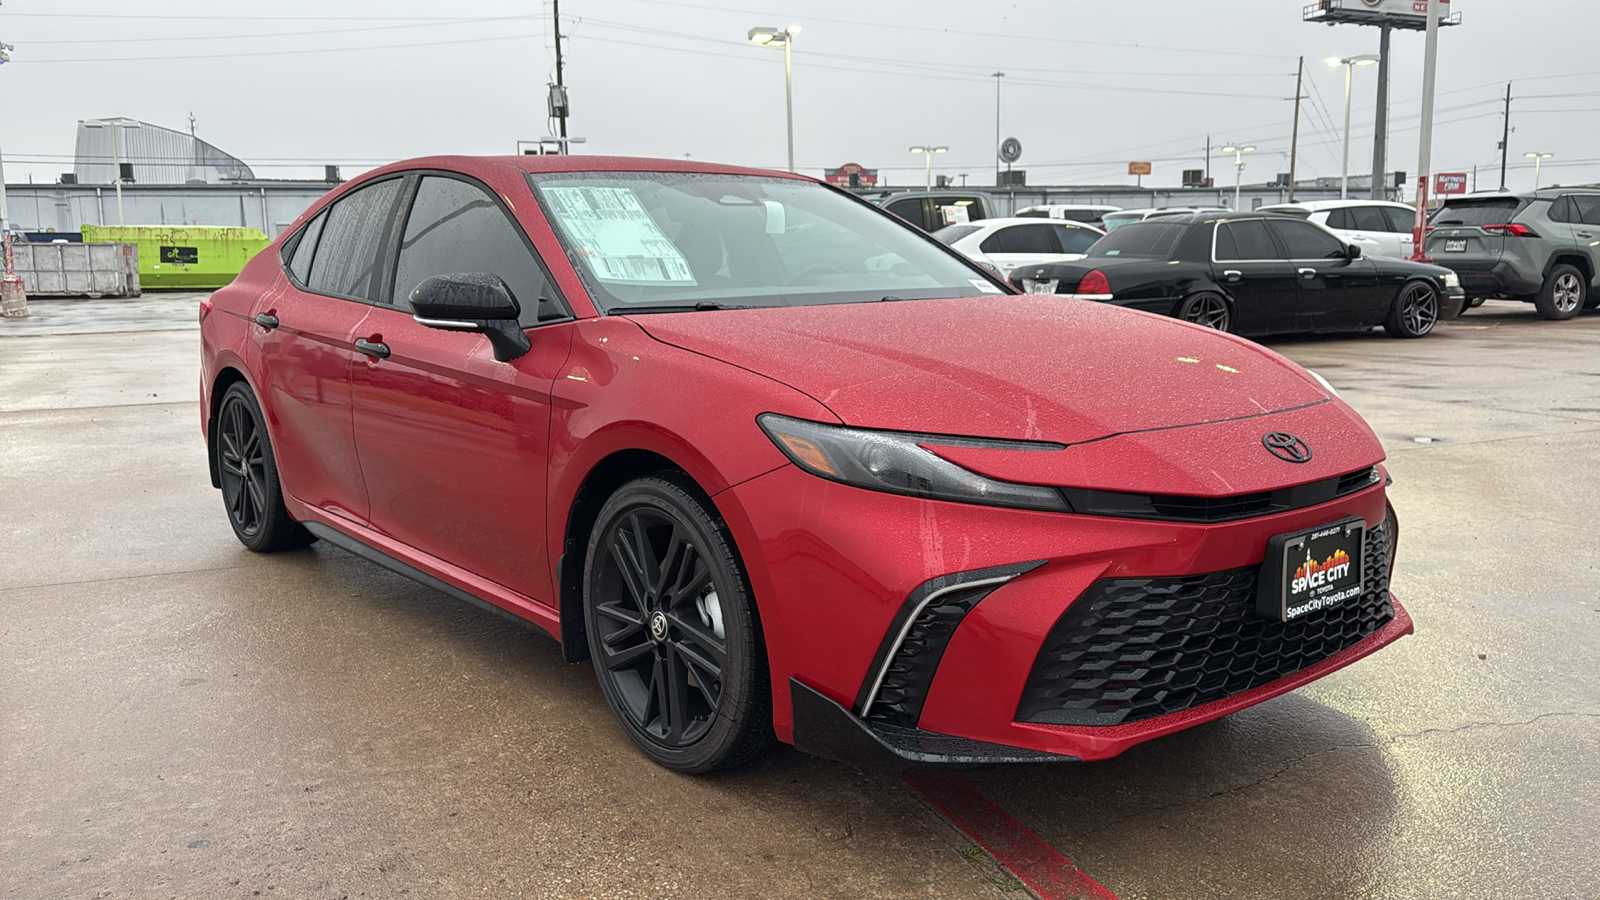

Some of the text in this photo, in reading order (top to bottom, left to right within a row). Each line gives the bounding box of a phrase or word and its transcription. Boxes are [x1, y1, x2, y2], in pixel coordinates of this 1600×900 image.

[1439, 175, 1465, 183] MATTRESS
[1444, 182, 1460, 191] FIRM
[1291, 562, 1350, 594] SPACE CITY
[1317, 584, 1334, 594] TOYOTA
[1286, 586, 1360, 618] SpaceCityToyota.com
